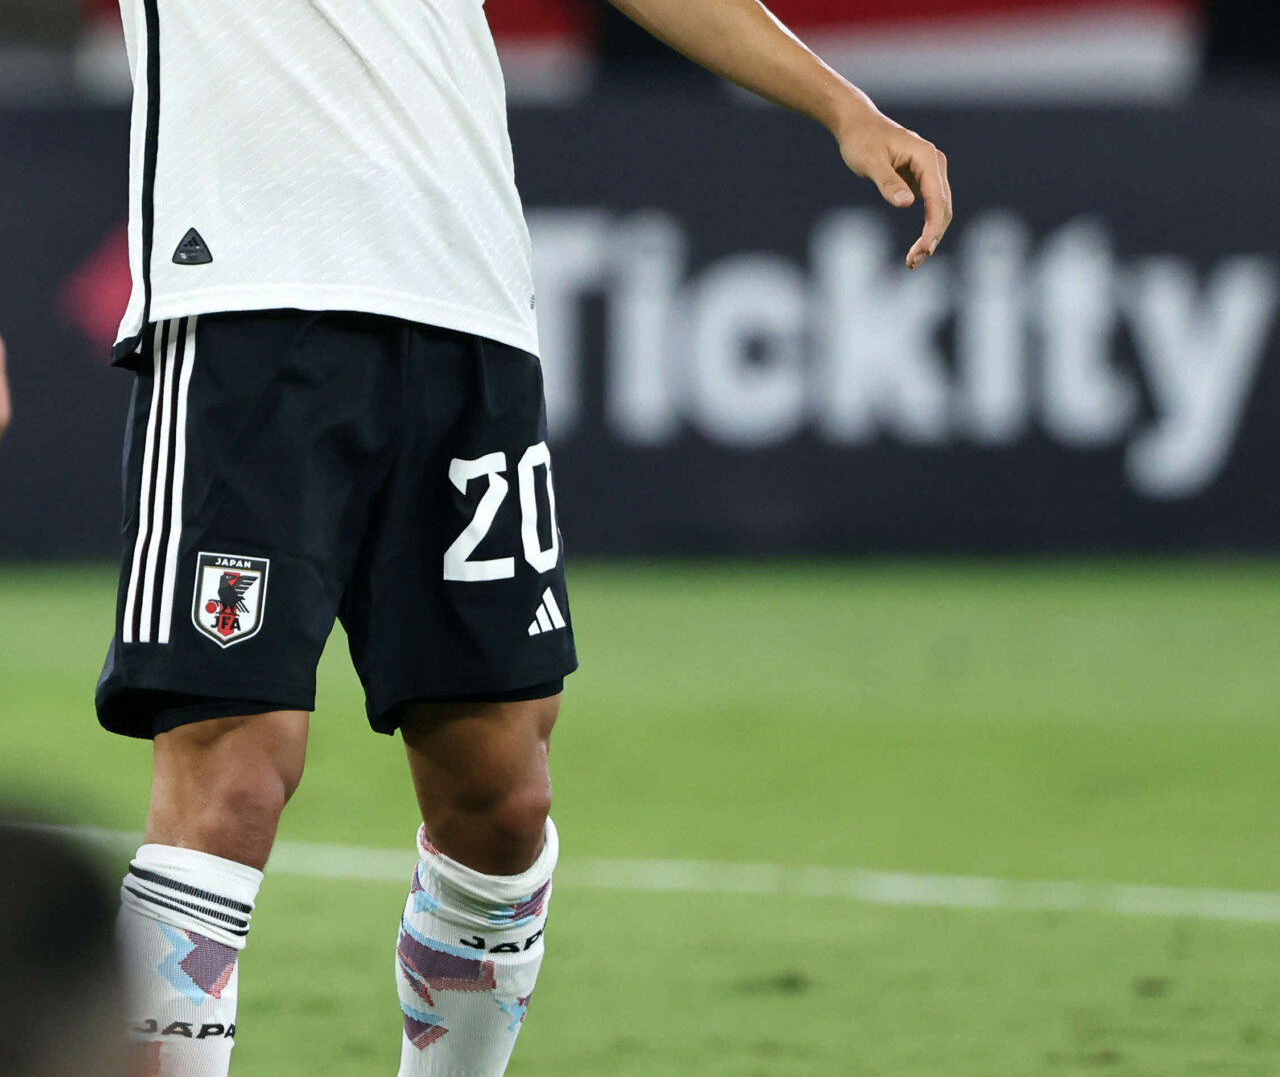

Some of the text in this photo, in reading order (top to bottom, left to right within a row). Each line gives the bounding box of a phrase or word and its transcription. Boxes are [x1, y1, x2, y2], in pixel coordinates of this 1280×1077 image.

[528, 212, 1276, 496] Tickity
[443, 441, 559, 582] 20
[215, 558, 251, 568] JAPAN
[211, 615, 241, 631] JFA
[134, 1019, 236, 1039] JAPA
